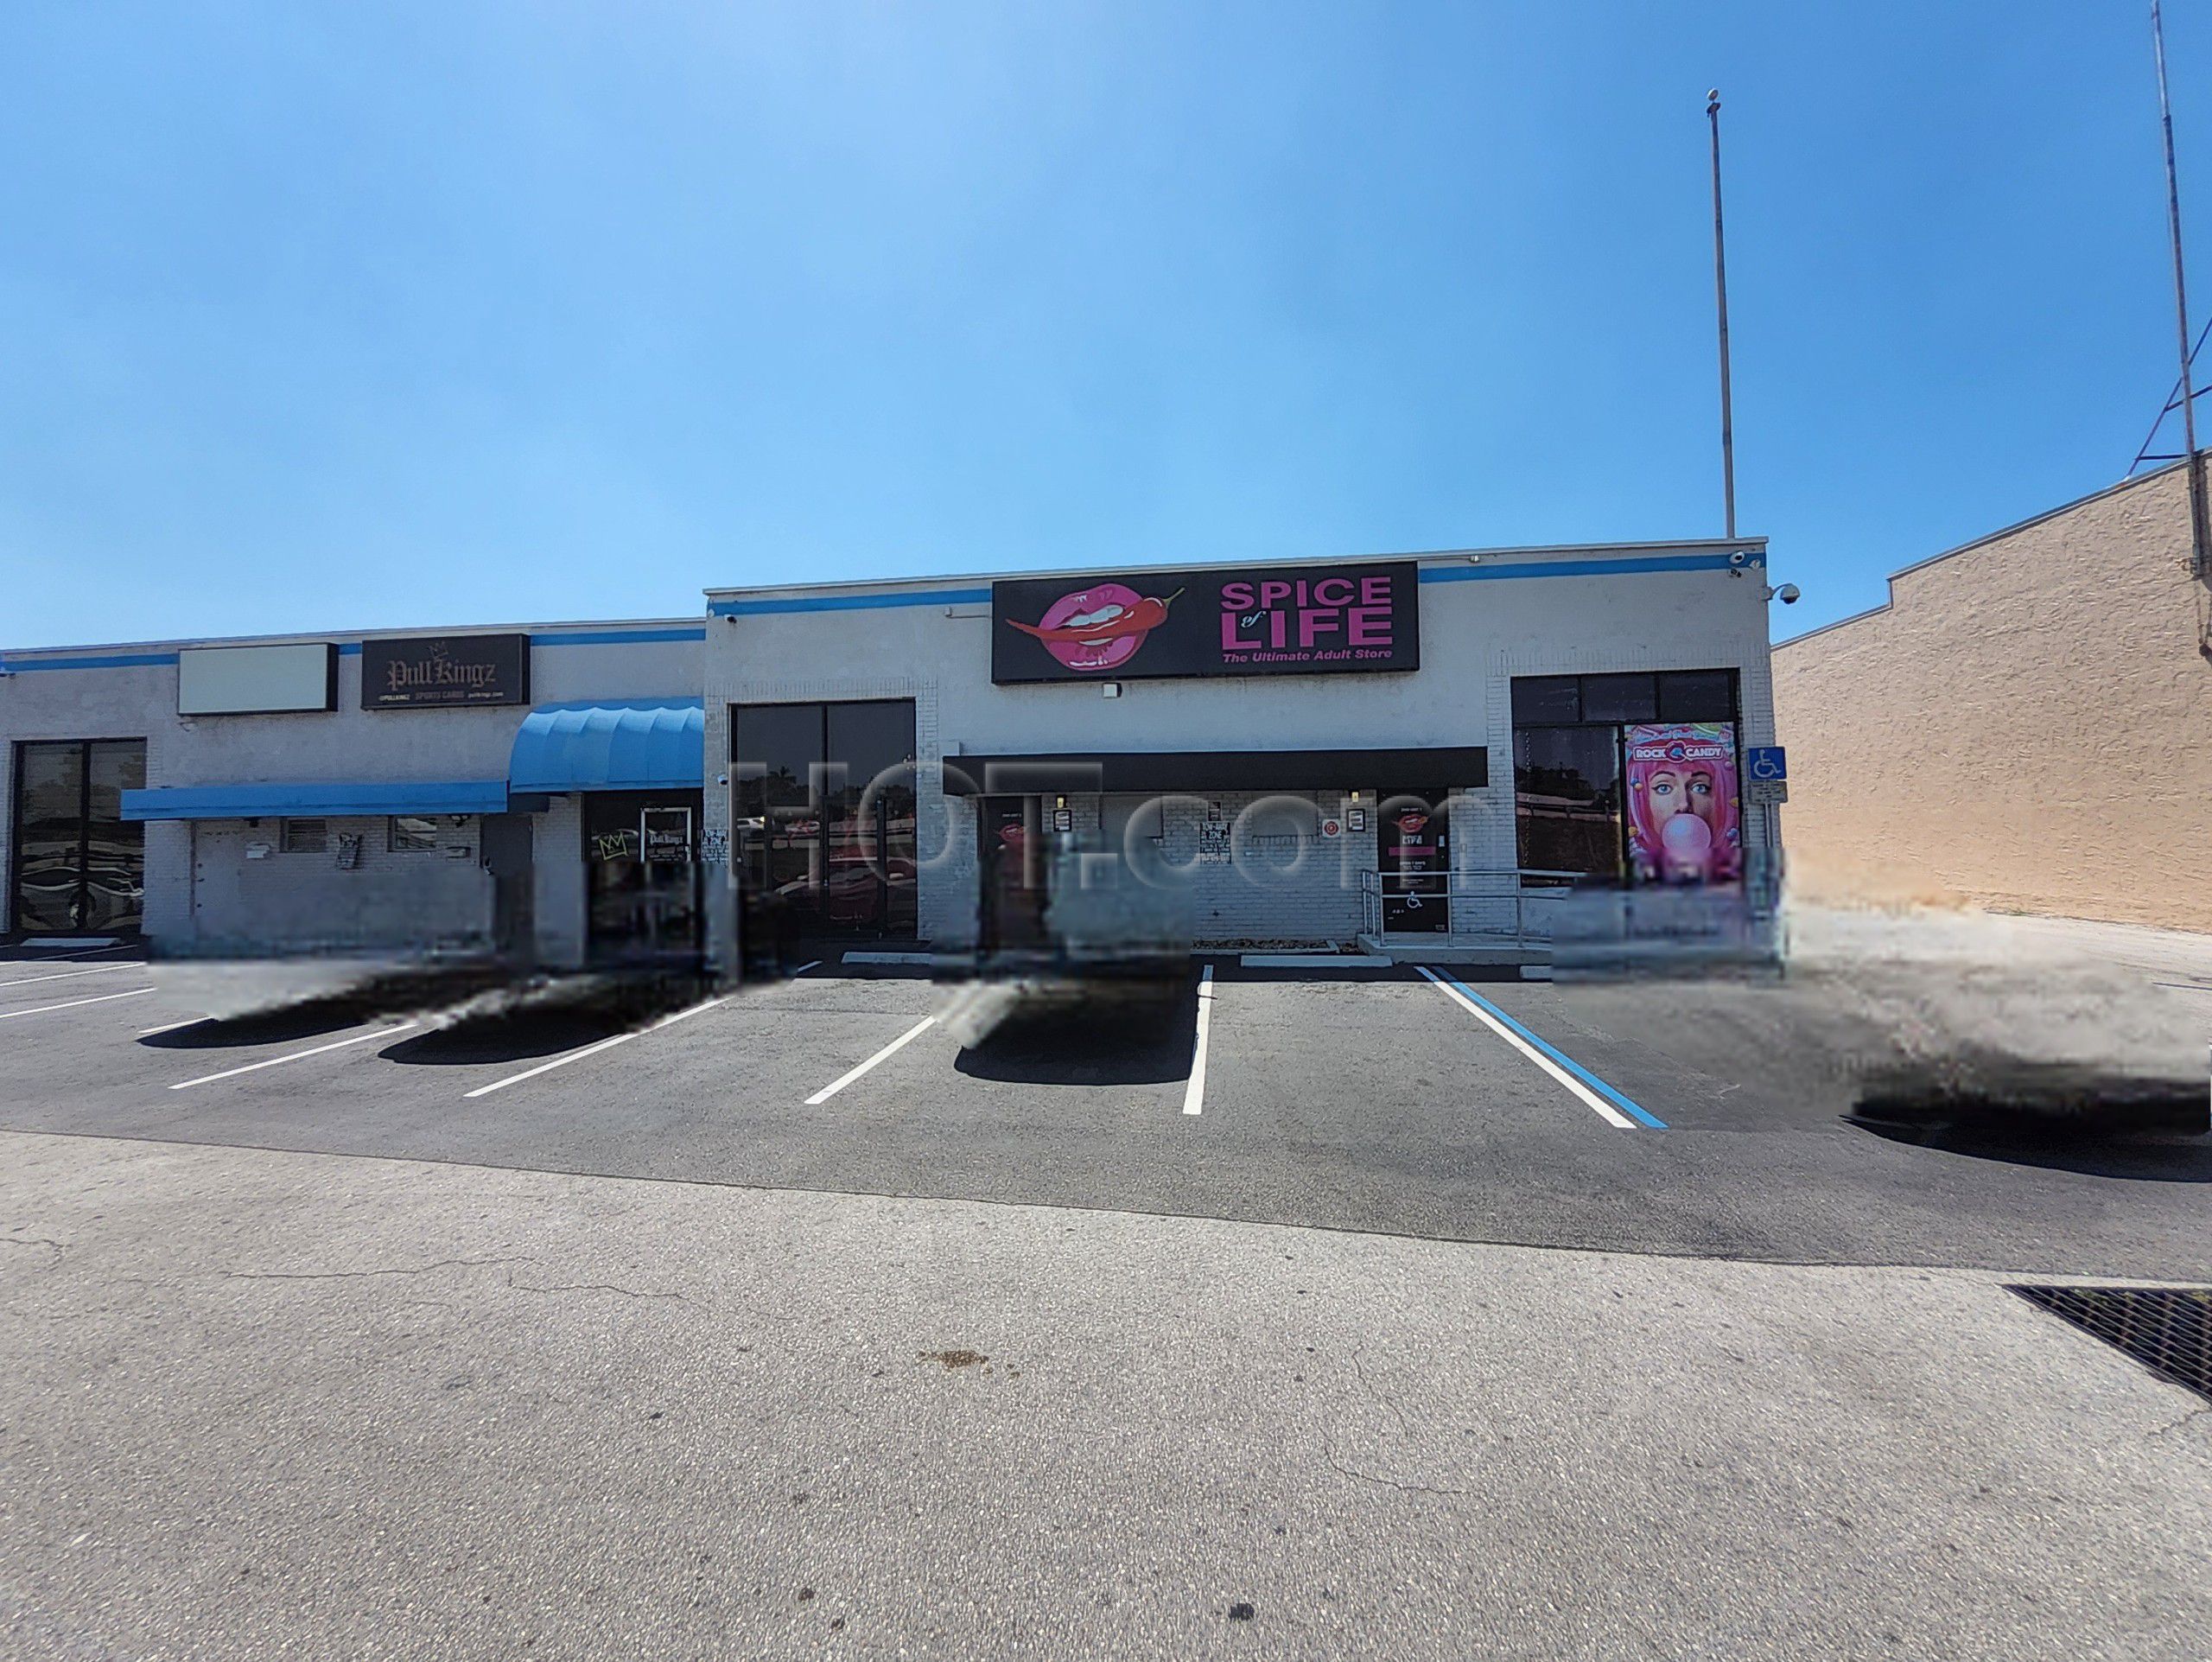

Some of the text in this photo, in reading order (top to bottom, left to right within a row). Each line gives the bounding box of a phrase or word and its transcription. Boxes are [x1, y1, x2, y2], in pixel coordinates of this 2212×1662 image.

[1221, 576, 1392, 610] SPICE
[1241, 610, 1267, 628] of
[1221, 606, 1393, 650] LIFE
[1223, 648, 1393, 664] The Ultimate Adult Store
[1635, 747, 1722, 759] ROCK CANDY
[1209, 831, 1223, 839] ZONE
